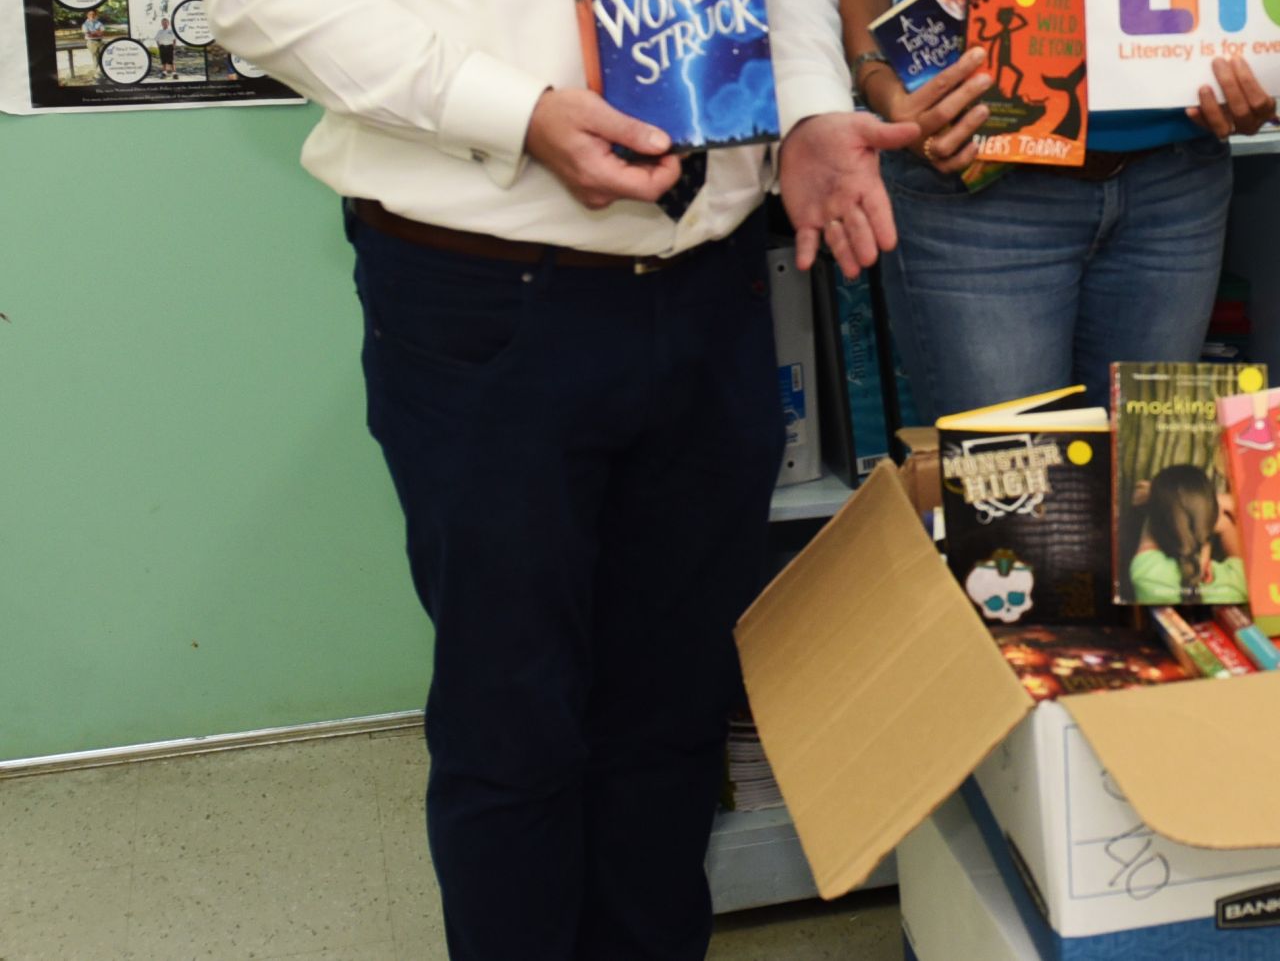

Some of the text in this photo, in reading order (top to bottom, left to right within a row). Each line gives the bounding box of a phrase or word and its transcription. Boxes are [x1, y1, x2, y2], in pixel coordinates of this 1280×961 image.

[896, 16, 946, 52] Tangle
[1037, 14, 1078, 34] WILD
[1028, 40, 1083, 57] BEYOND
[1118, 41, 1193, 61] Literacy
[1200, 41, 1215, 56] is
[1221, 38, 1245, 56] for
[907, 51, 923, 76] of
[1126, 395, 1217, 421] mocking
[942, 443, 1064, 479] MONSTER
[963, 469, 1050, 505] HIGH
